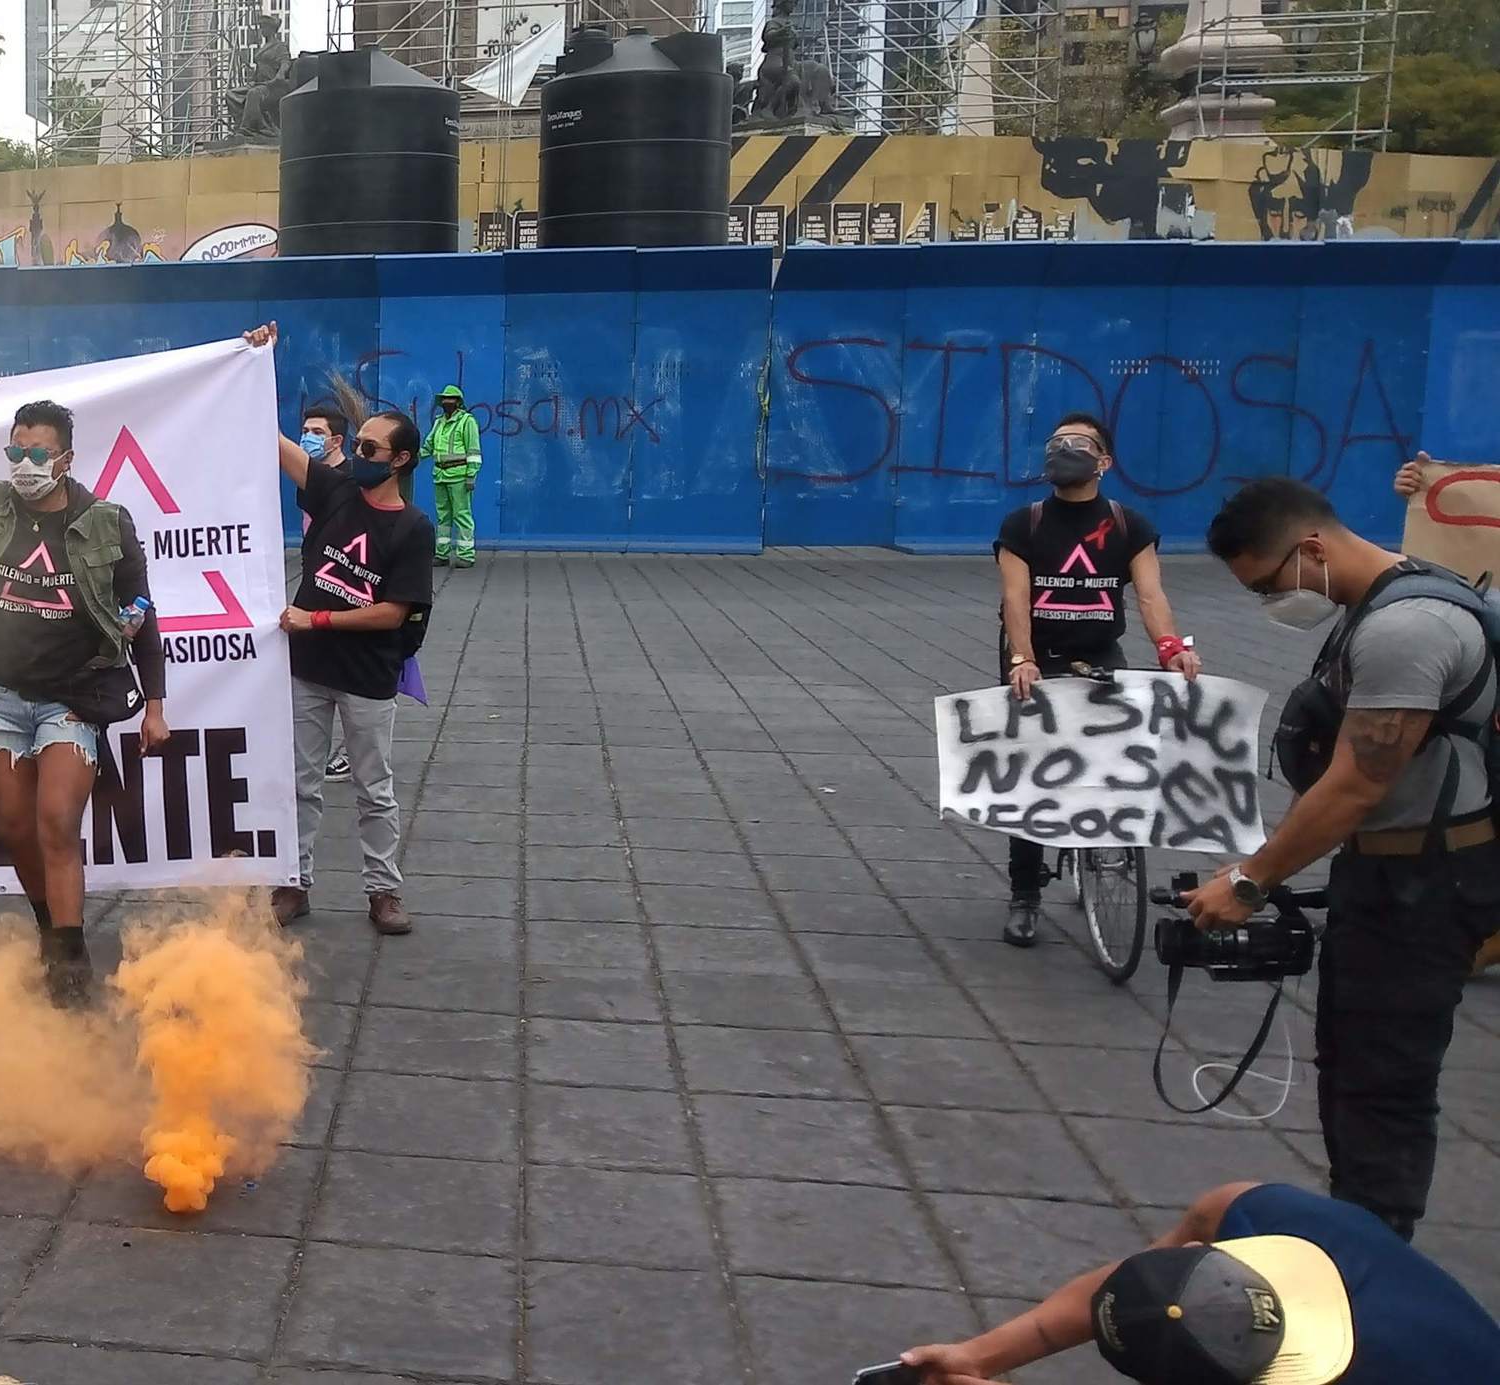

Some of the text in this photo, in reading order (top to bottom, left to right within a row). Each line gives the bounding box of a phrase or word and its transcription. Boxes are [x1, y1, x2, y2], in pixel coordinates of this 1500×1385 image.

[774, 337, 1413, 497] SIDOSA
[153, 523, 252, 560] MUERTE
[42, 573, 76, 587] MUERTE
[1034, 576, 1075, 588] SILENCIO
[1084, 577, 1120, 588] MUERTE
[954, 682, 1057, 743] LA
[958, 748, 1086, 795] NO
